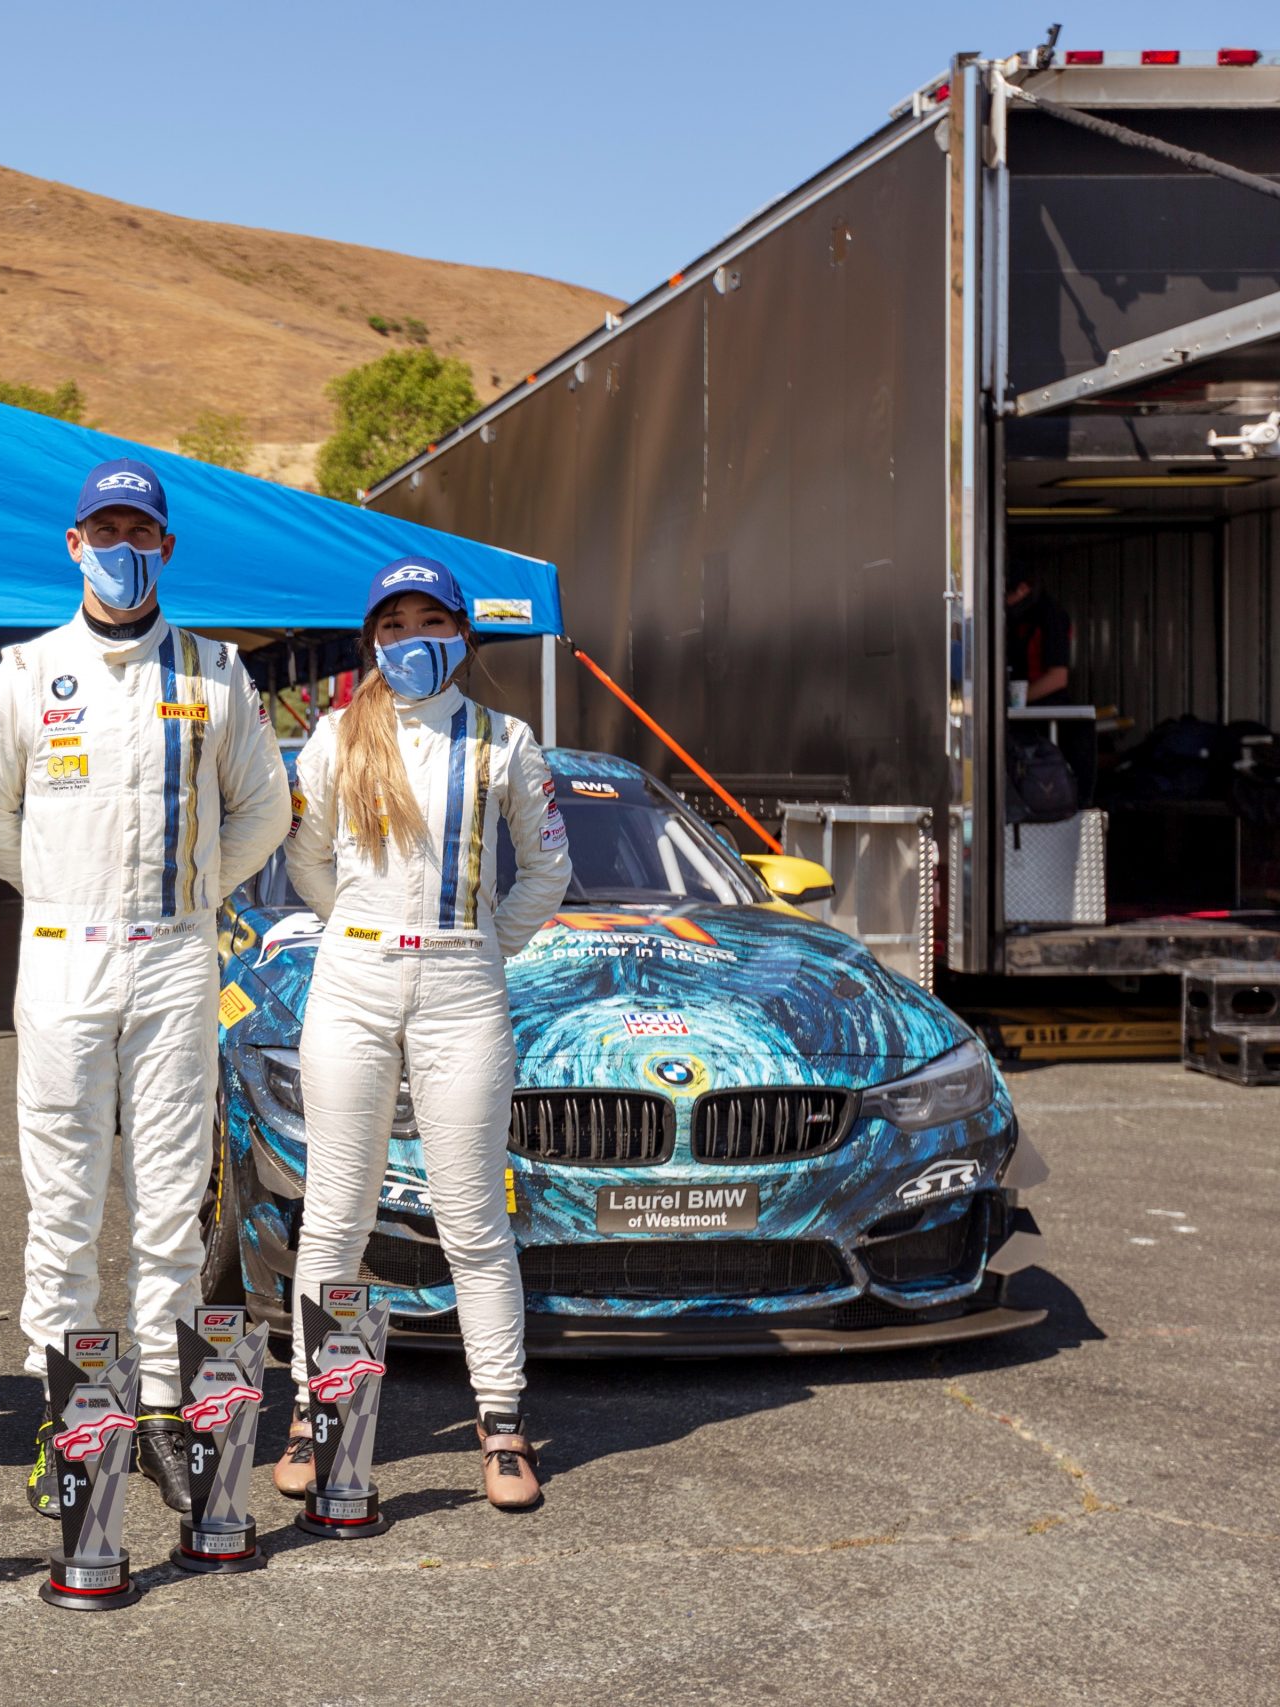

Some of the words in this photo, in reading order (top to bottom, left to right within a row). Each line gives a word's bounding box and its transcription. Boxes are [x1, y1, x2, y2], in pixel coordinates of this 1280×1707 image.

[43, 706, 88, 725] GT4
[161, 705, 205, 719] PIRELLI
[47, 754, 88, 779] GPI
[571, 780, 615, 792] aws
[36, 928, 63, 939] Sabelt
[172, 923, 197, 934] Miller
[348, 928, 378, 940] Sabelt
[423, 938, 466, 948] Samantha
[470, 939, 483, 948] Tan
[553, 946, 623, 961] partner
[636, 946, 653, 957] in
[625, 1013, 683, 1024] LIQUI
[629, 1024, 686, 1034] MOLY
[609, 1191, 681, 1210] Laurel
[688, 1188, 747, 1209] BMW
[628, 1215, 642, 1228] of
[645, 1212, 728, 1228] Westmont
[329, 1289, 362, 1302] GT4
[204, 1314, 238, 1327] GT4
[76, 1337, 111, 1351] GT4
[315, 1413, 338, 1444] 3rd
[191, 1443, 214, 1474] 3rd
[63, 1474, 87, 1507] 3rd
